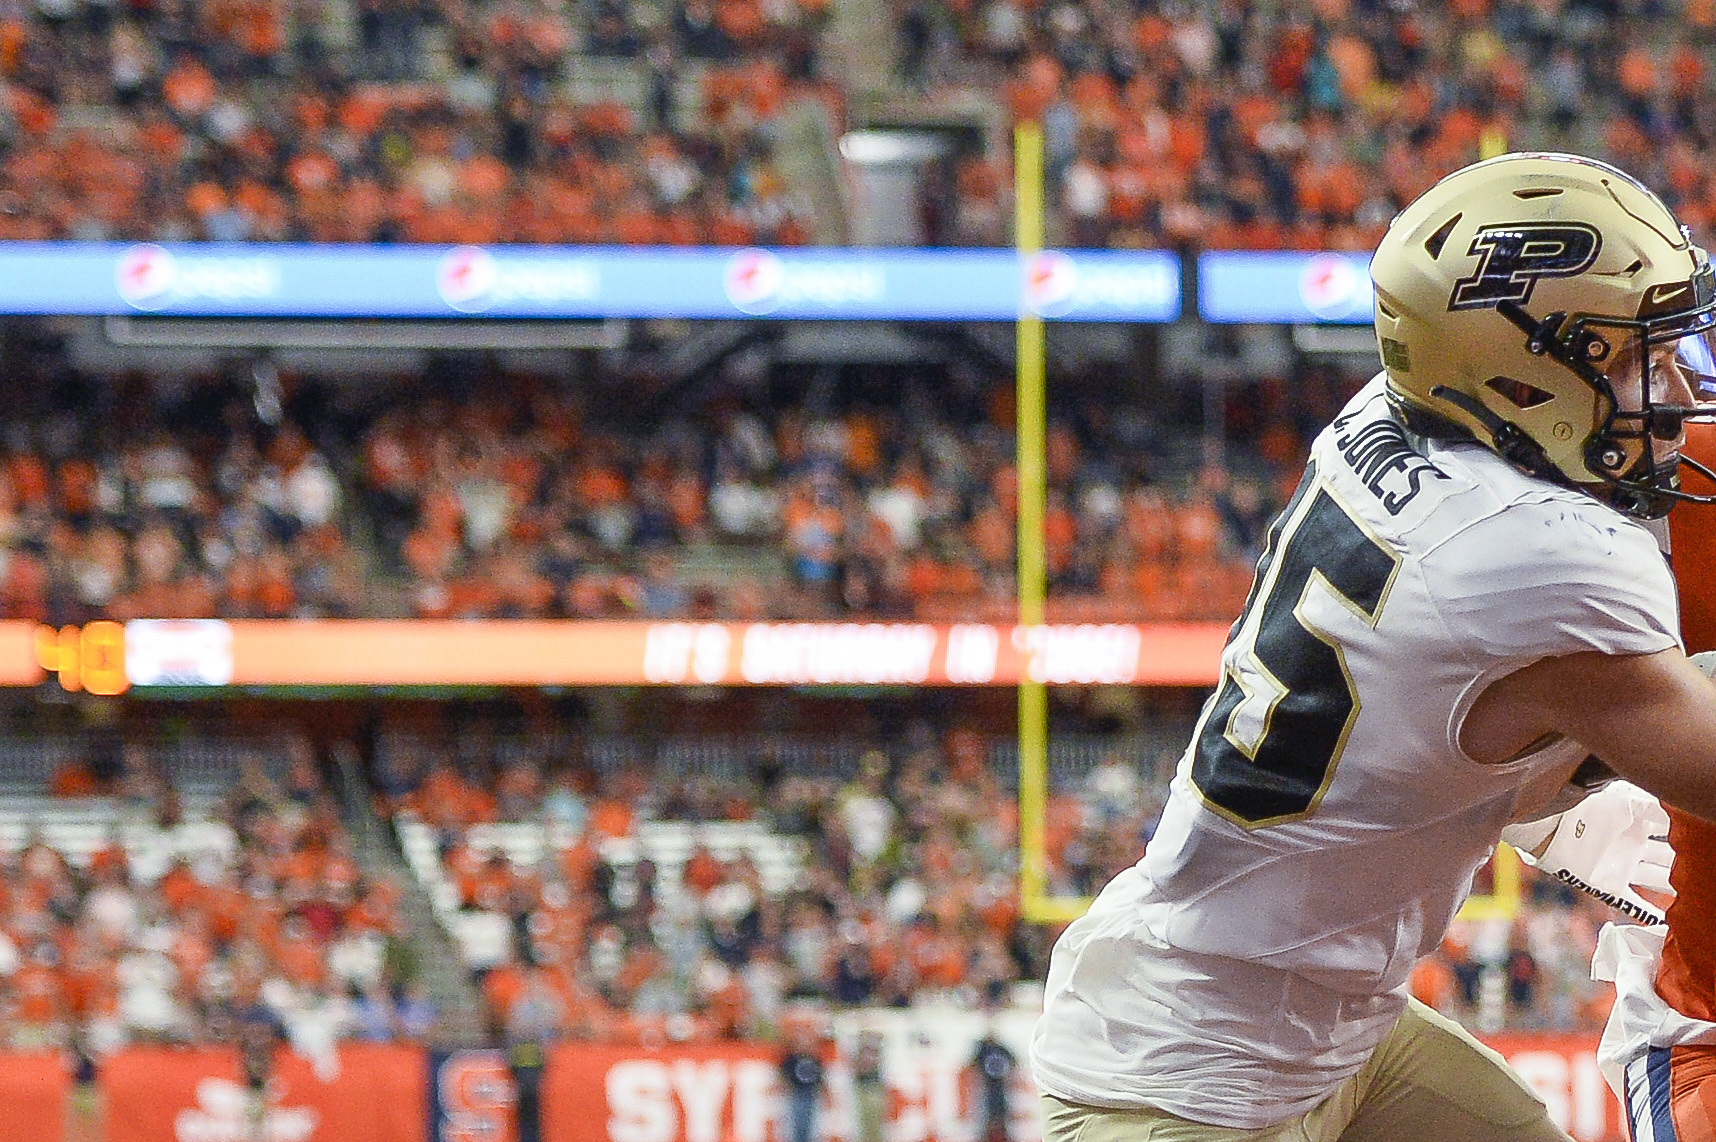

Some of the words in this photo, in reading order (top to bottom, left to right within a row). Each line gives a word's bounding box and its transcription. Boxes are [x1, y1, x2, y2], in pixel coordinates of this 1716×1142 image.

[1446, 220, 1604, 312] P
[1336, 419, 1452, 516] JONES
[1553, 868, 1666, 926] OILERMAKERS
